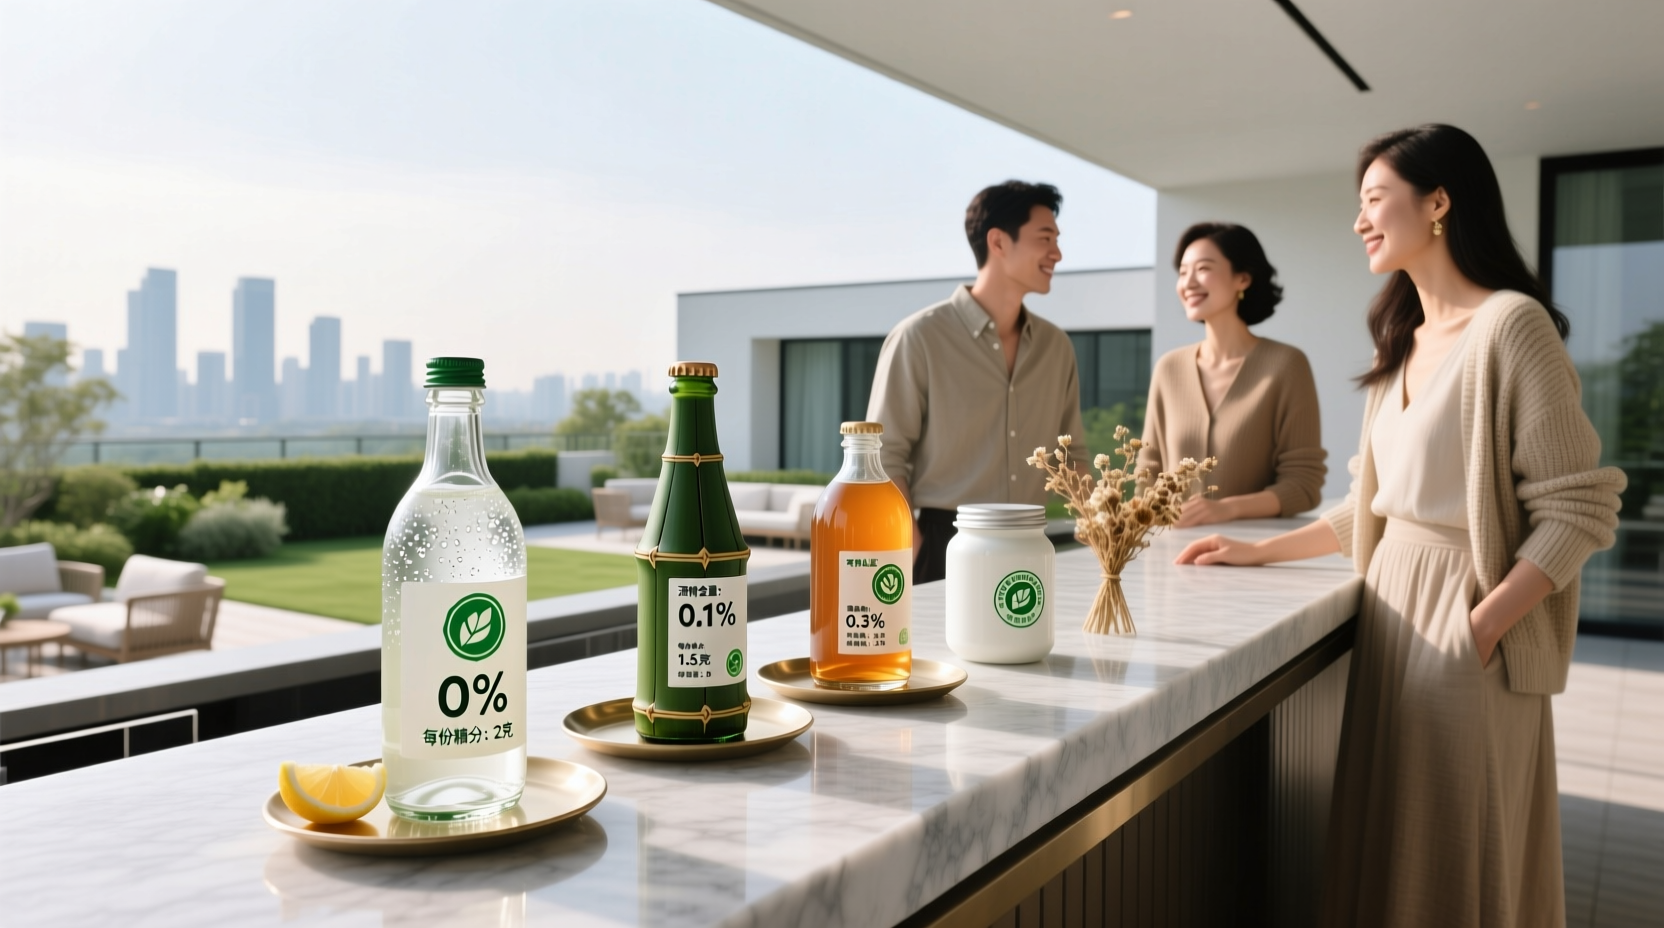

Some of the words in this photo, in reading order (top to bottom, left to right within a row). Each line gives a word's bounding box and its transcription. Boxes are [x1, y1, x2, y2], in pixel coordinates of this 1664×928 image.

[678, 600, 736, 627] 0.1%
[846, 612, 885, 629] 0.3%
[438, 671, 508, 718] 0%
